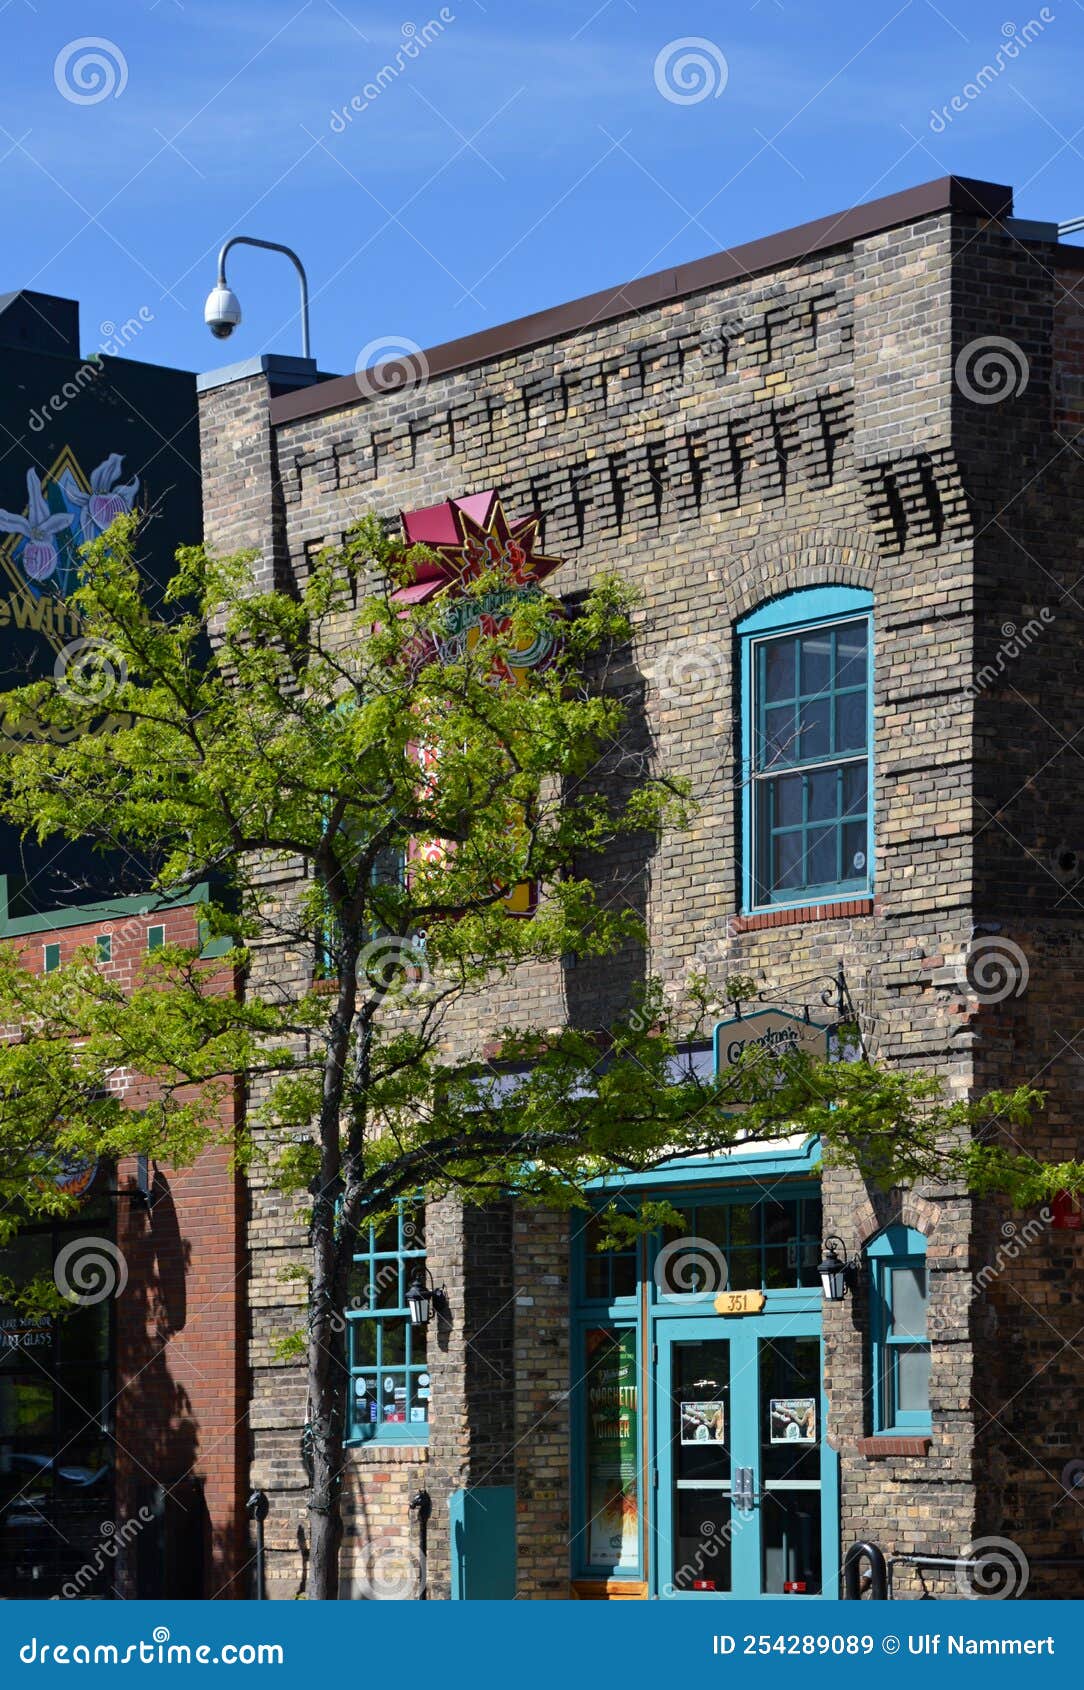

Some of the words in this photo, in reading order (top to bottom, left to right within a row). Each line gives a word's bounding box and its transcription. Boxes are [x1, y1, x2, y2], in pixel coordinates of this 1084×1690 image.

[728, 1294, 747, 1311] 351
[2, 1334, 20, 1347] ART
[24, 1332, 52, 1346] GLASS
